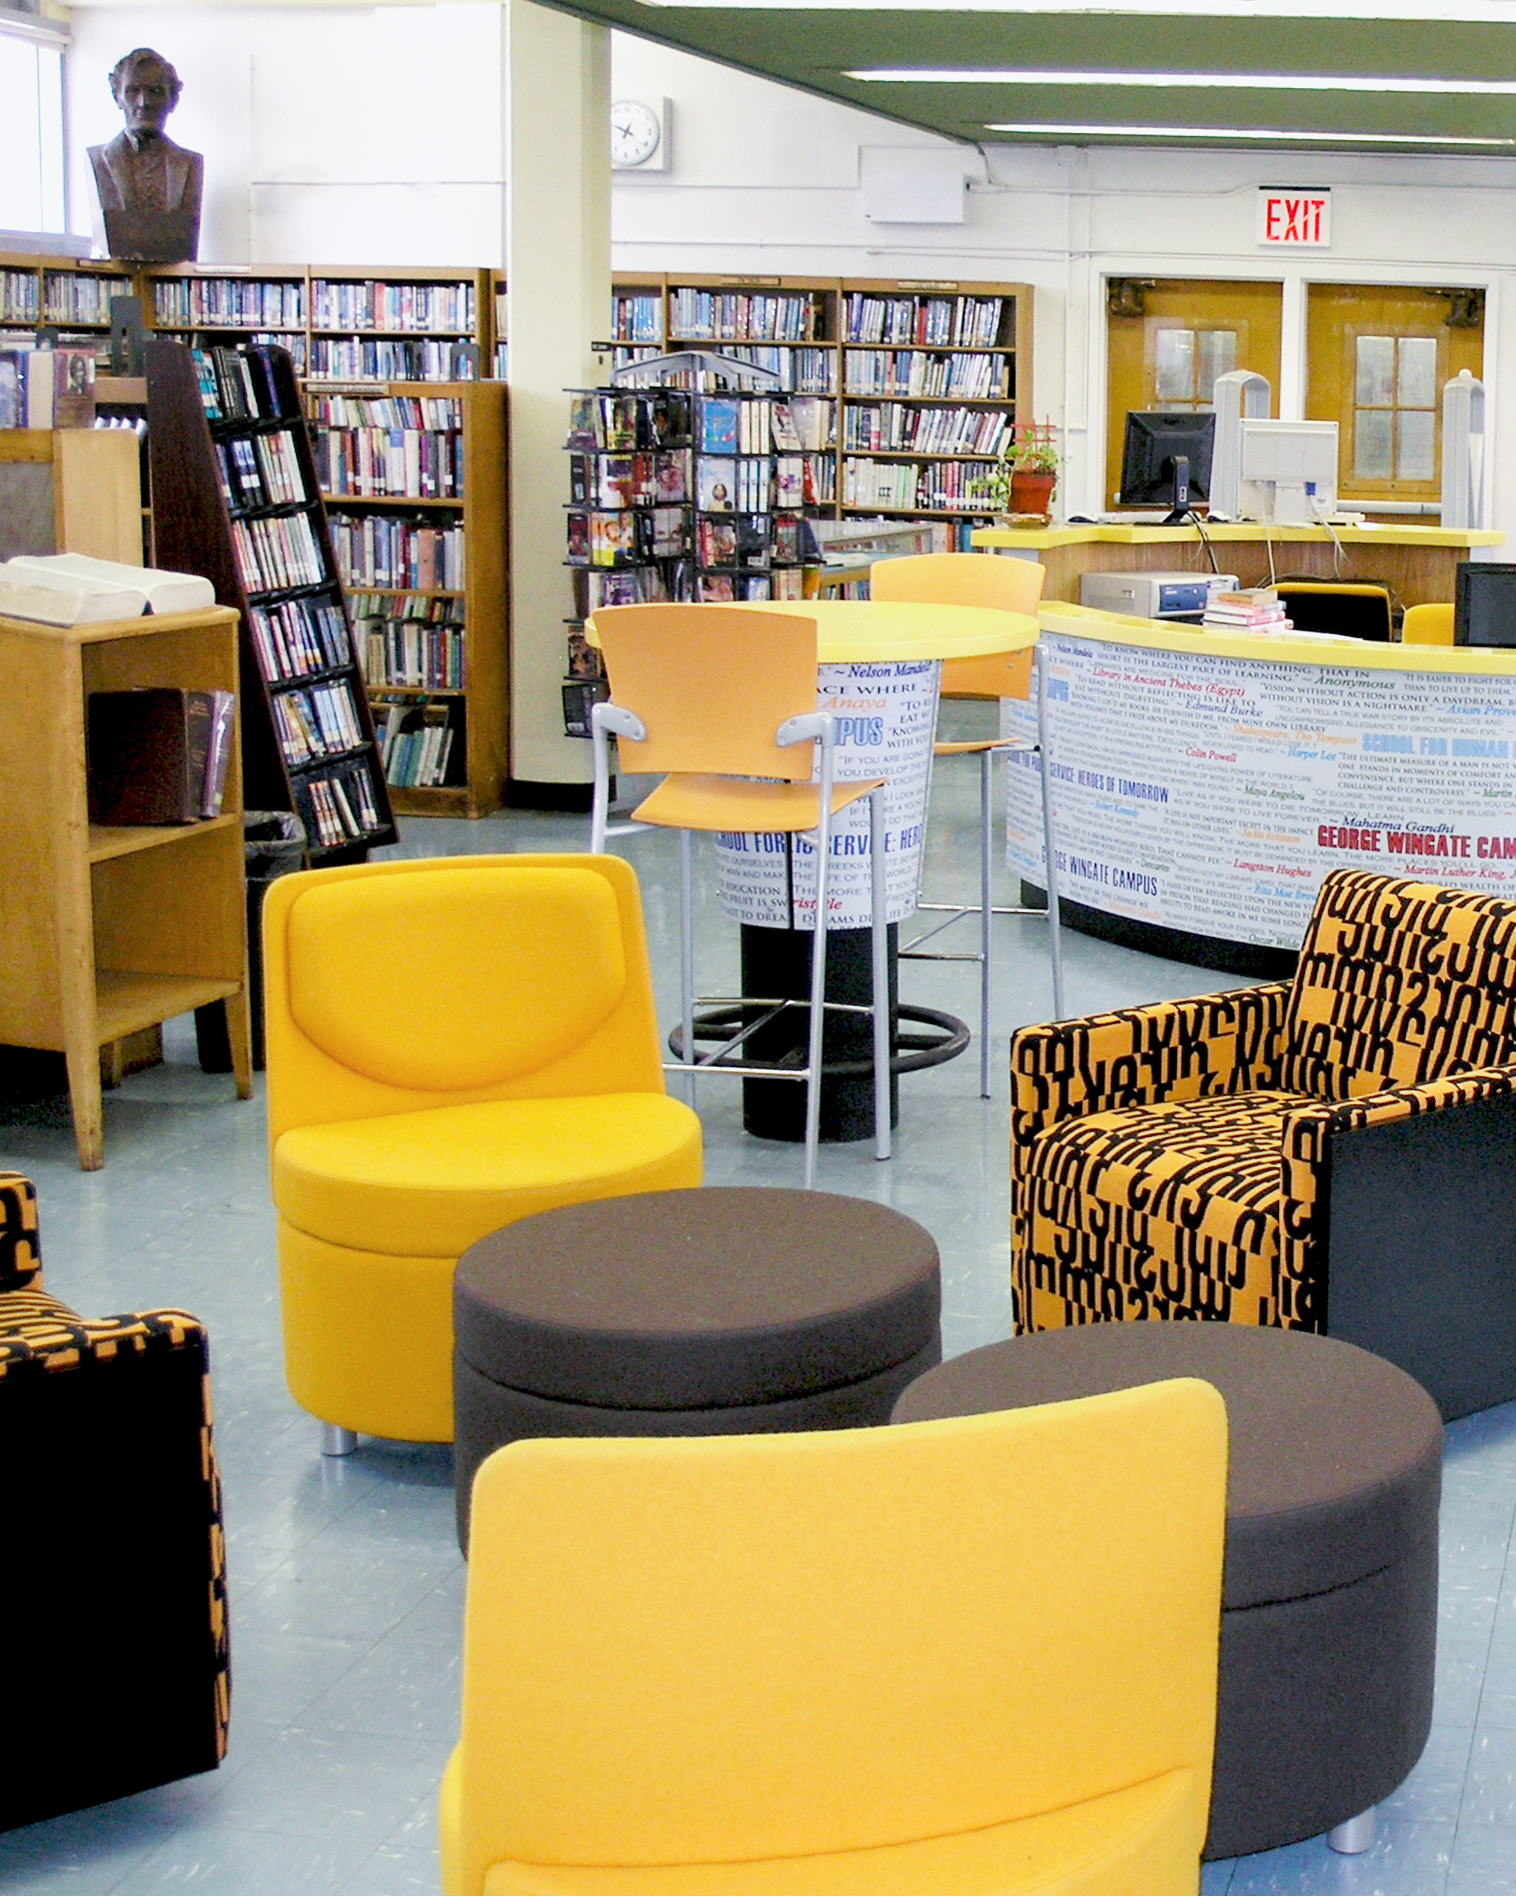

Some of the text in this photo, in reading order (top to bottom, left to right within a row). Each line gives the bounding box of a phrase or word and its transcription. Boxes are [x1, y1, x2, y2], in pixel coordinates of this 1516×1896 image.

[1266, 199, 1325, 241] EXIT
[848, 664, 892, 678] Nelson
[1141, 648, 1171, 660] WHERE
[1173, 652, 1193, 663] YOU
[1195, 655, 1217, 665] CAN
[1220, 658, 1247, 668] FIND
[1319, 667, 1349, 678] THAT
[1354, 670, 1370, 678] IN
[1092, 667, 1246, 698] Library in Ancient Thebes (Egypt)
[1192, 665, 1216, 675] PART
[1218, 668, 1232, 677] OF
[1315, 675, 1396, 690] Anonymous
[857, 683, 916, 695] WHERE
[1147, 686, 1201, 701] REFLECTING
[1242, 699, 1256, 707] TO
[1297, 686, 1344, 697] WITHOUT
[1347, 690, 1386, 700] ACTION
[1390, 692, 1398, 700] IS
[1401, 693, 1430, 702] ONLY
[822, 696, 887, 712] Anaya
[1185, 700, 1228, 713] Edmund
[1230, 705, 1263, 717] Burke
[1260, 693, 1303, 704] WITHOUT
[1306, 696, 1339, 706] VISION
[1447, 704, 1481, 716] Asian
[1185, 746, 1237, 762] Colin Powell
[1400, 757, 1436, 766] MEASURE
[1438, 759, 1449, 767] OF
[1077, 769, 1105, 791] HEROES
[1106, 776, 1115, 793] OF
[1118, 778, 1169, 804] TOMORROW
[1342, 816, 1401, 830] Mahatma
[1406, 821, 1455, 833] Gandhi
[1317, 825, 1381, 852] GEORGE
[1386, 831, 1471, 858] WINGATE
[1070, 855, 1109, 885] WINGATE
[1112, 867, 1158, 897] CAMPUS
[1233, 858, 1274, 873] Langston
[1276, 864, 1311, 878] Hughes
[1403, 864, 1438, 876] Martin
[1441, 866, 1476, 878] Luther
